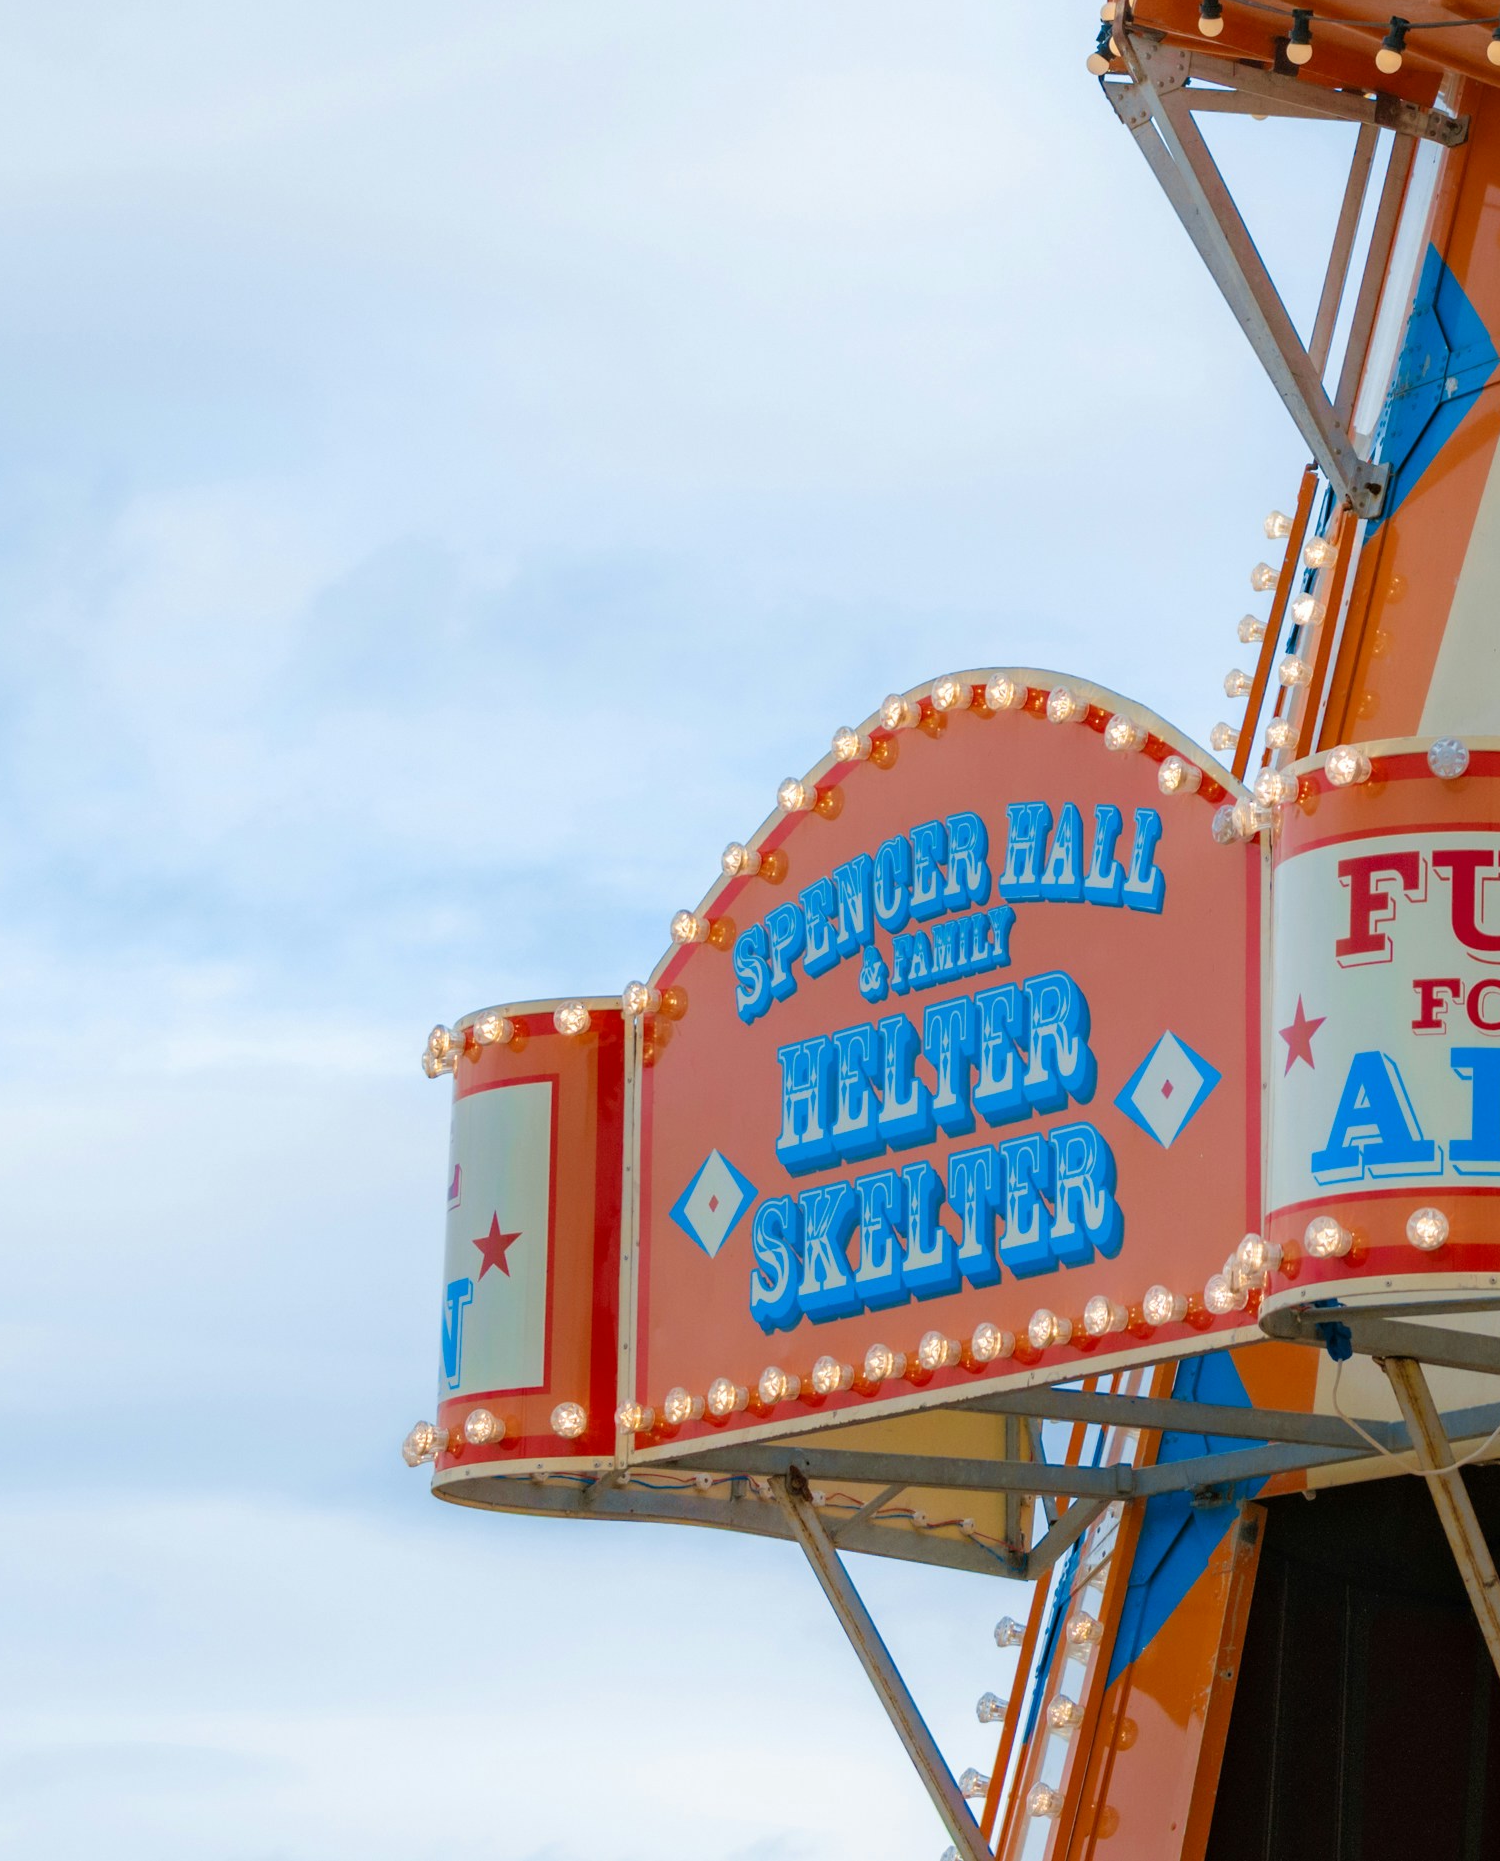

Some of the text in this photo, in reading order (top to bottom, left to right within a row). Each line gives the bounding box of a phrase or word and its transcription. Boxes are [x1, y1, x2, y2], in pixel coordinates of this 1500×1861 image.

[733, 802, 1164, 1024] SPENCER HALL
[858, 906, 1016, 1002] & FAMILY
[775, 970, 1098, 1177] HELTER
[749, 1121, 1124, 1336] SKELTER
